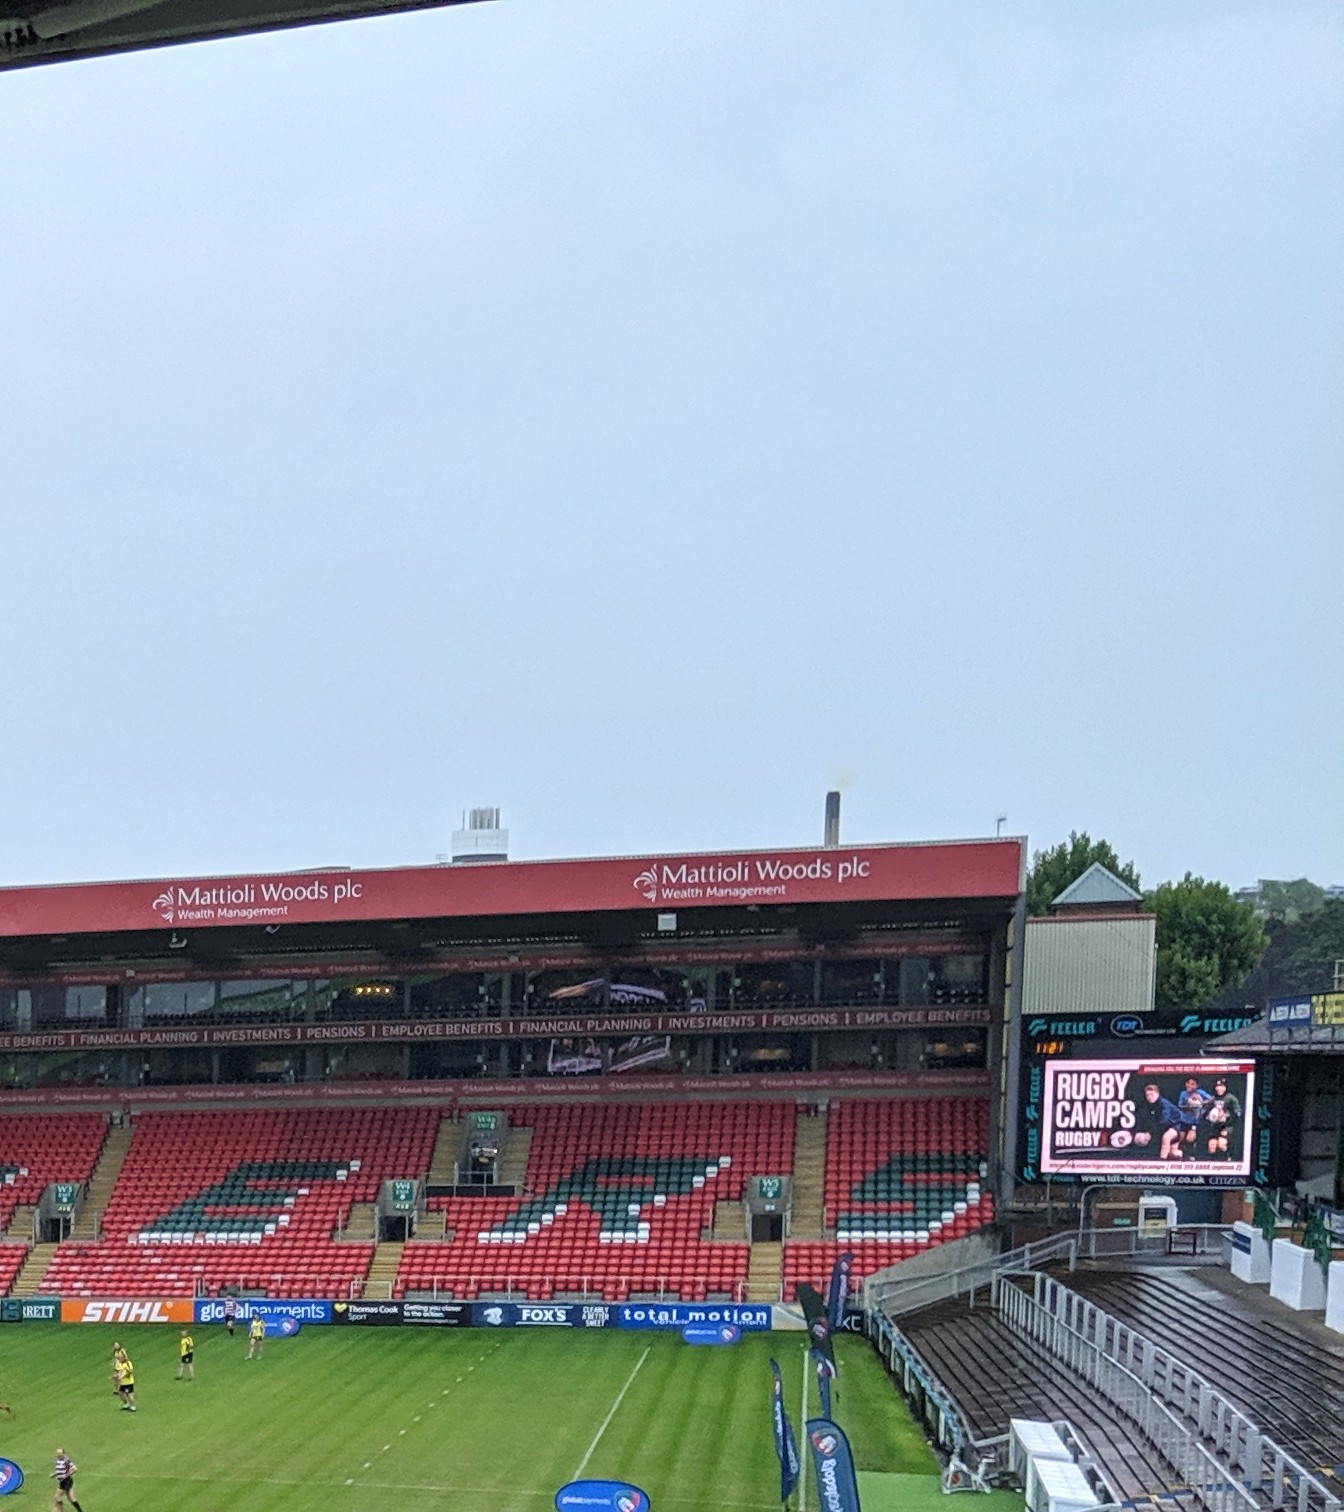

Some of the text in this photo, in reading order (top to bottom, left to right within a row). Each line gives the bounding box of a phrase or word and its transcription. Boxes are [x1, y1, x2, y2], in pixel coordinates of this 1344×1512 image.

[661, 856, 870, 885] Mattioli Woods plc
[177, 879, 363, 907] Mattioli Woods plc
[661, 884, 786, 899] Wealth Management
[177, 906, 288, 920] Wealth Management
[13, 1034, 65, 1047] BENEFITS
[80, 1031, 137, 1045] FINANCIAL
[140, 1029, 198, 1044] PLANNING
[212, 1028, 291, 1042] INVESTMENTS
[307, 1025, 366, 1039] PENSIONS
[382, 1023, 443, 1037] EMPLOYEE
[446, 1021, 502, 1035] BENEFITS
[519, 1019, 584, 1033] FINANCIAL
[586, 1017, 651, 1031] PLANNING
[668, 1015, 756, 1029] INVESTMENTS
[773, 1013, 839, 1026] PENSIONS
[857, 1010, 925, 1024] EMPLOYEE
[927, 1008, 991, 1022] BENEFITS
[1056, 1072, 1131, 1101] RUGBY
[1055, 1100, 1136, 1129] CAMPS
[1055, 1131, 1101, 1147] RUGBY
[81, 1302, 169, 1322] STIHL
[200, 1302, 325, 1322] gloalpayments
[348, 1305, 399, 1314] Thomas Cook
[522, 1308, 567, 1322] FOX'S
[623, 1308, 678, 1322] total
[688, 1308, 768, 1322] motion
